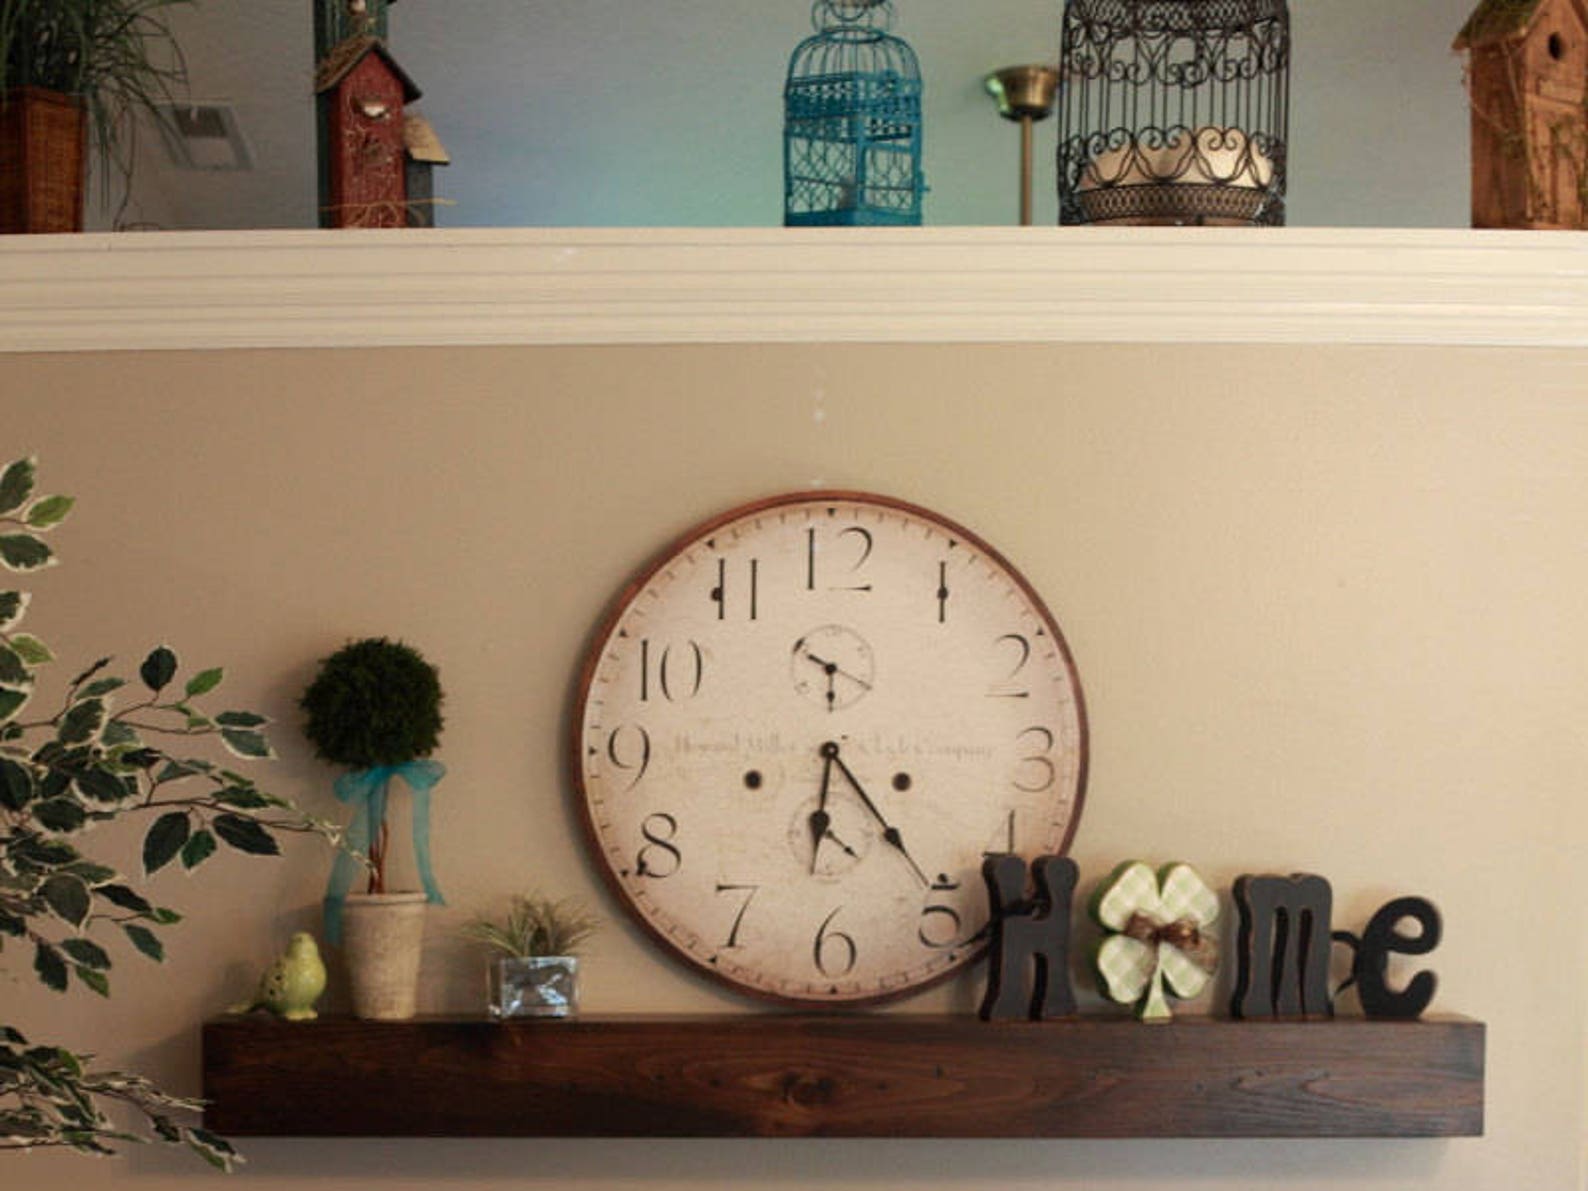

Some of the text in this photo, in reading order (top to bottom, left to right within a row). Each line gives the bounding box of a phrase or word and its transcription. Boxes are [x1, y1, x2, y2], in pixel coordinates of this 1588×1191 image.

[717, 558, 758, 621] 11
[805, 527, 873, 591] 12
[640, 639, 702, 702] 10
[984, 633, 1031, 698] 2
[607, 723, 651, 792] 9
[1012, 726, 1055, 793] 3
[636, 812, 682, 879] 8
[716, 884, 761, 948] 7
[812, 905, 858, 978] 6
[918, 881, 962, 948] 5
